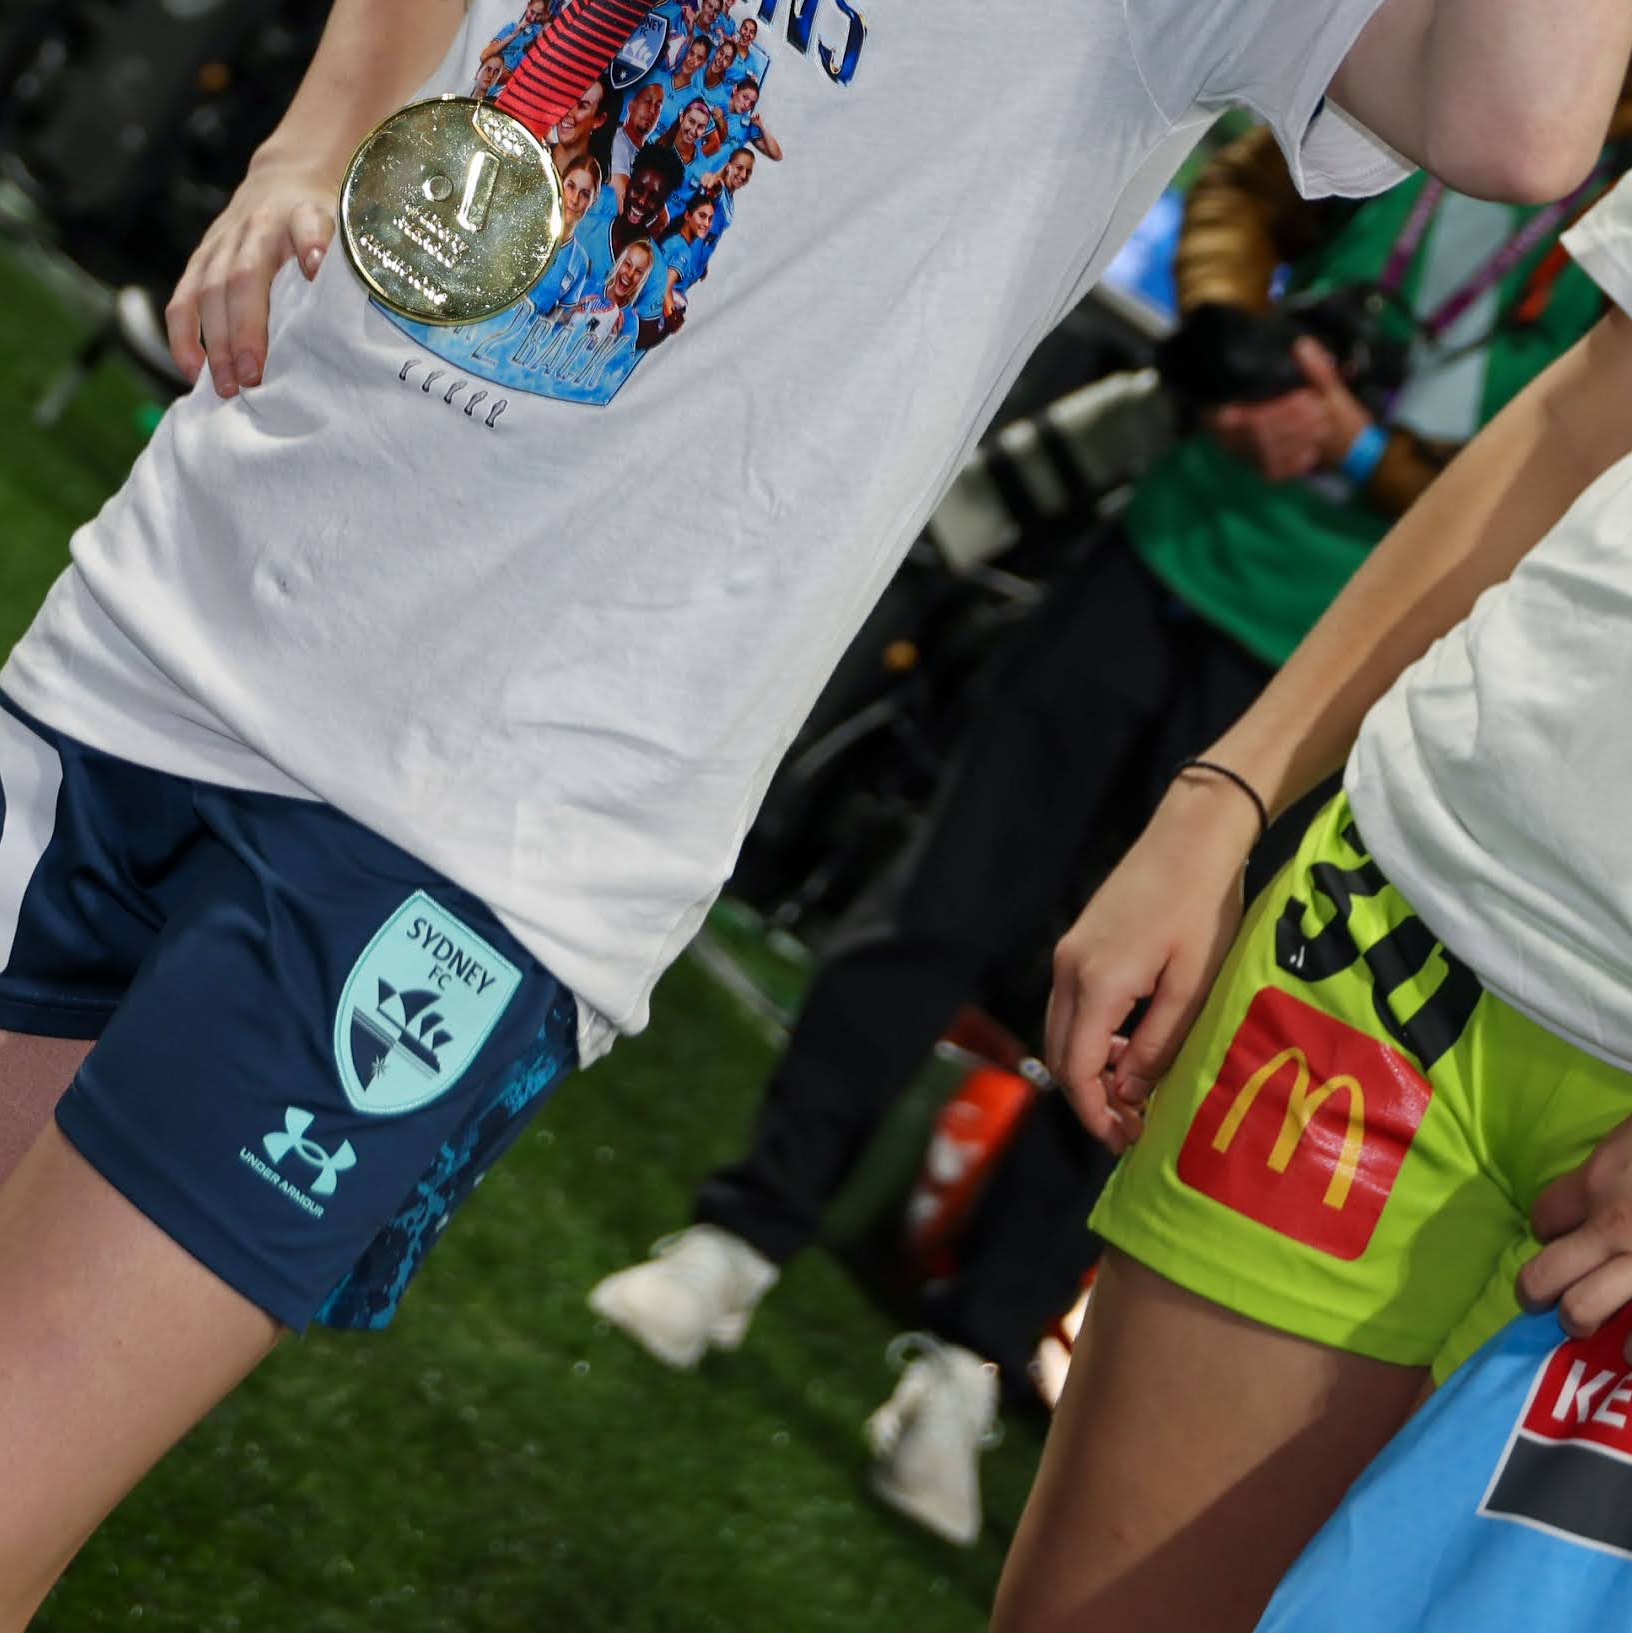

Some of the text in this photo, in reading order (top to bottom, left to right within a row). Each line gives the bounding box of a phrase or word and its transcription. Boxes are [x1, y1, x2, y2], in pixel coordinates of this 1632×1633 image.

[406, 917, 496, 996] SYDNEY
[428, 963, 453, 992] FC
[239, 1146, 325, 1219] UNDER ARMOUR
